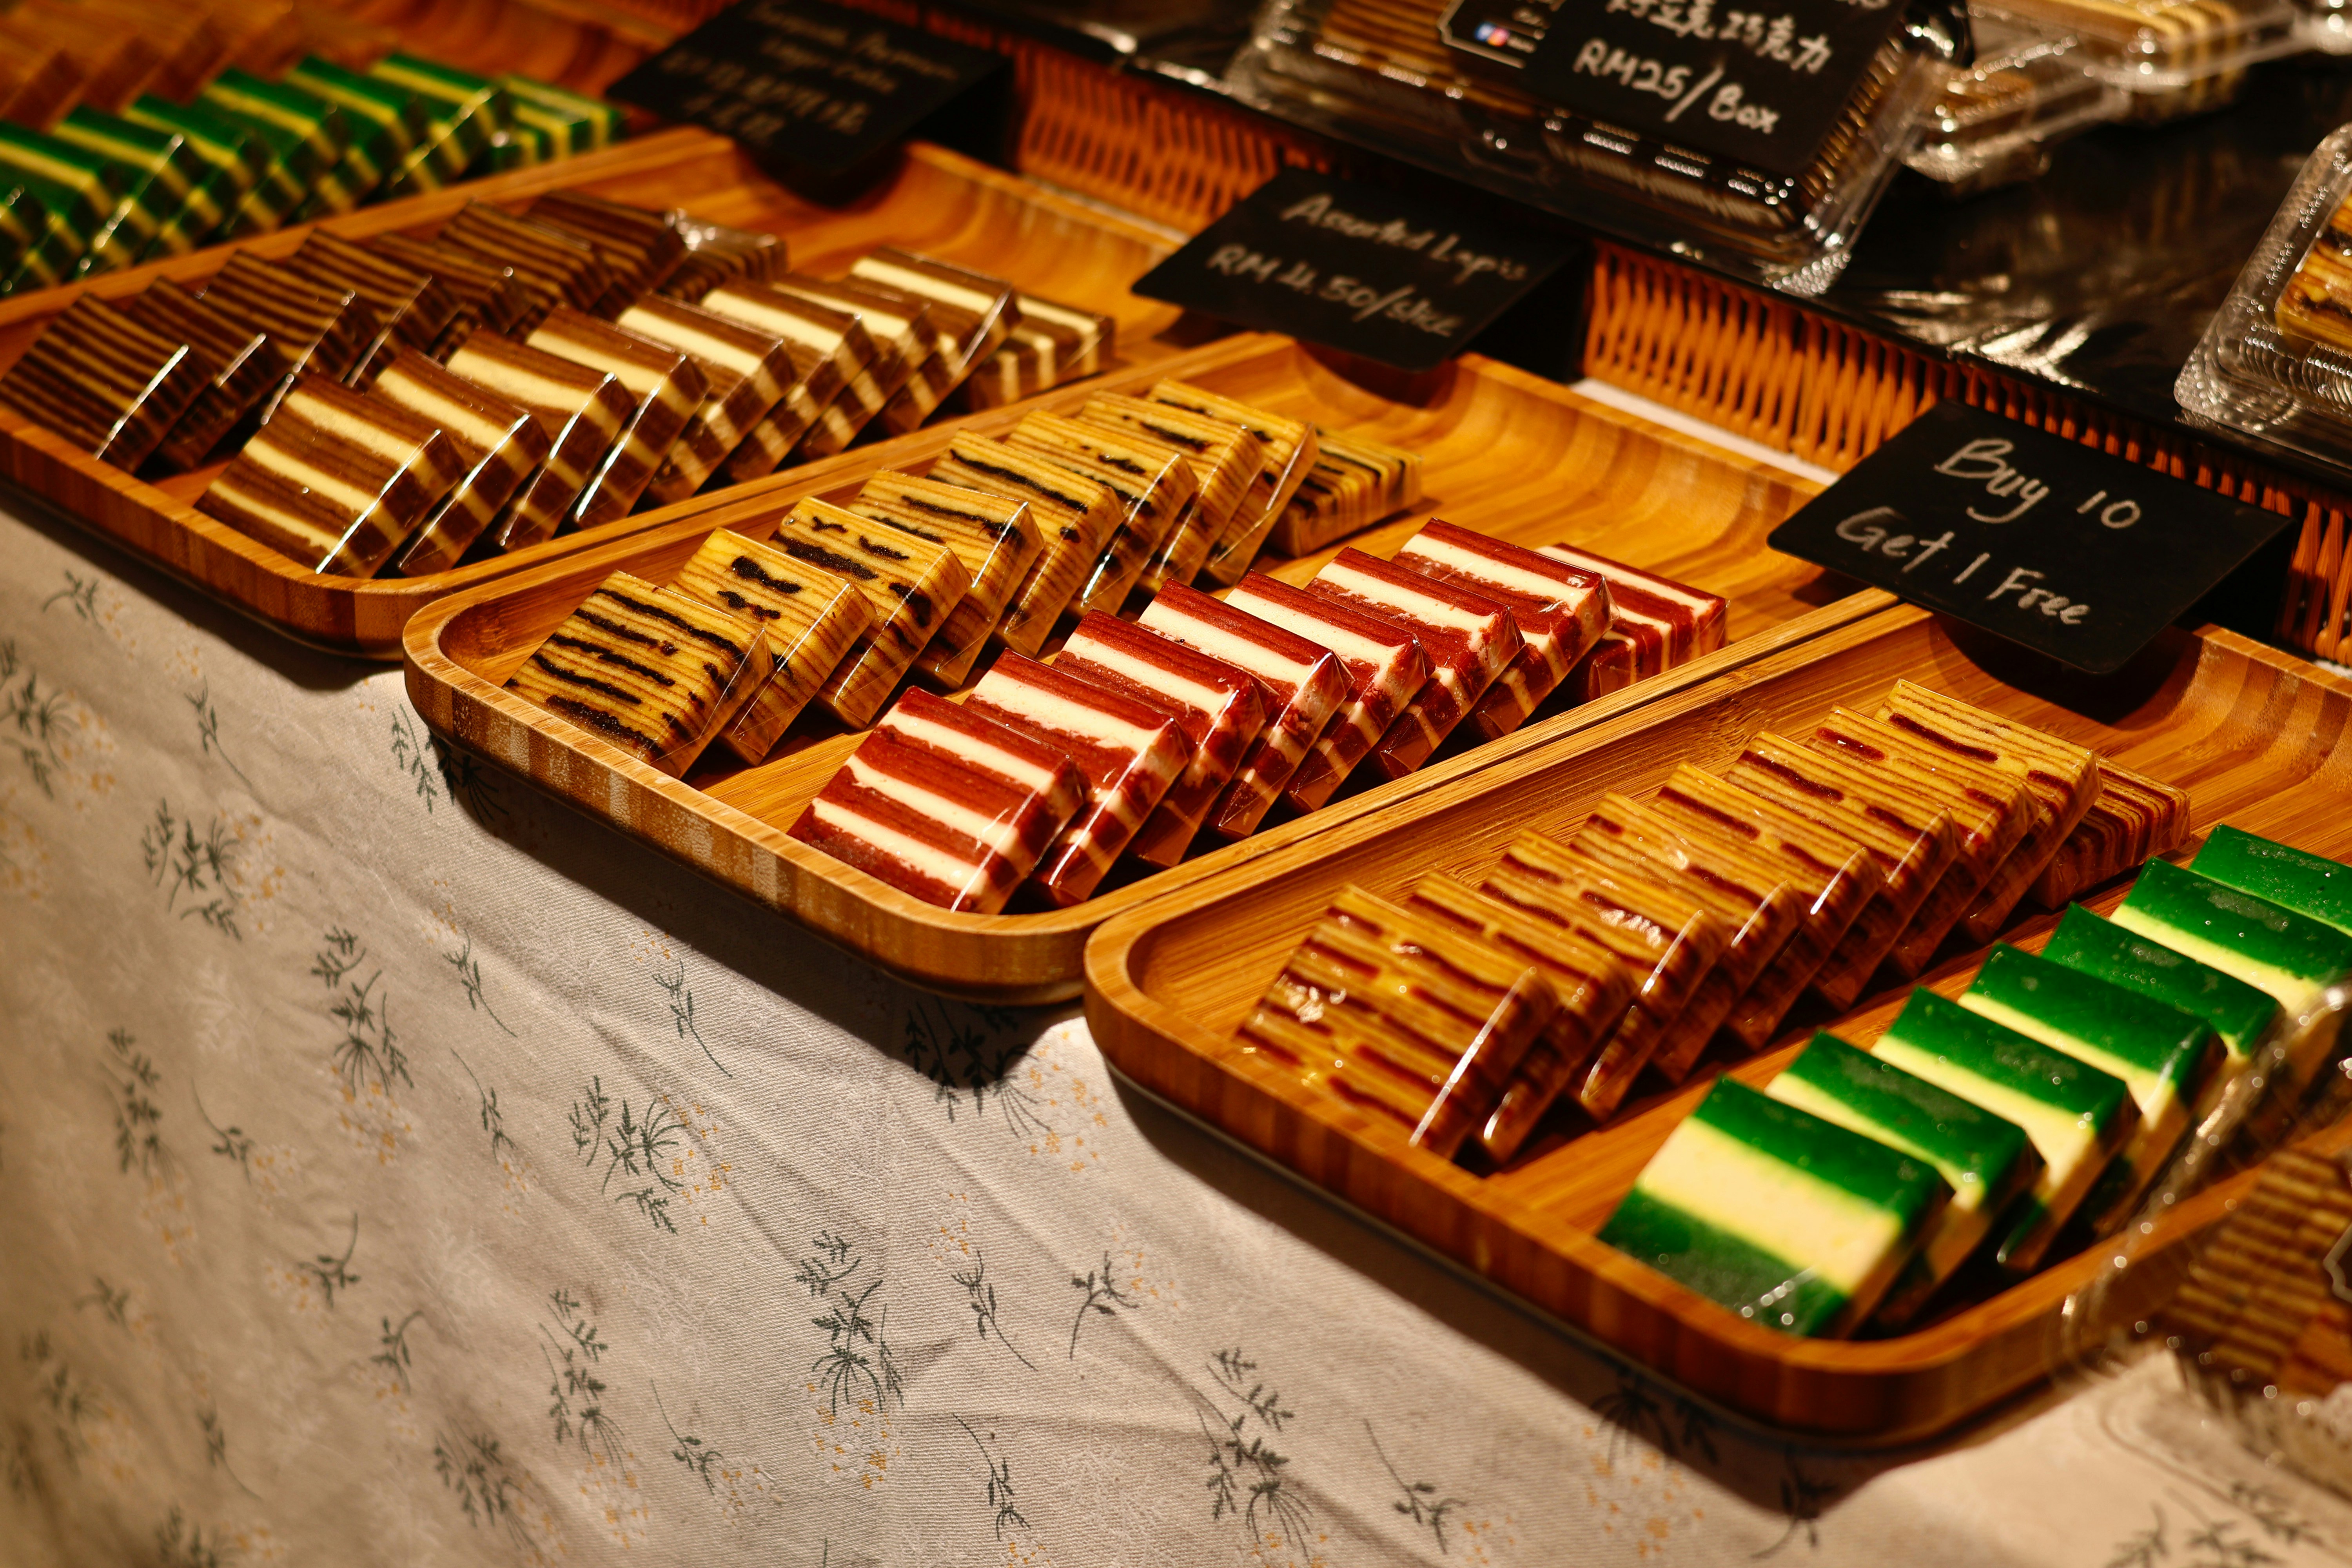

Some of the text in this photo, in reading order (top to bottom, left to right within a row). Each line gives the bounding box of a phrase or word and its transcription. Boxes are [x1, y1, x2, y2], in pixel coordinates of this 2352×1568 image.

[1573, 38, 1780, 134] RM25/Box
[1934, 438, 2141, 529] Buy 10
[1835, 506, 2091, 625] Get 1 Free
